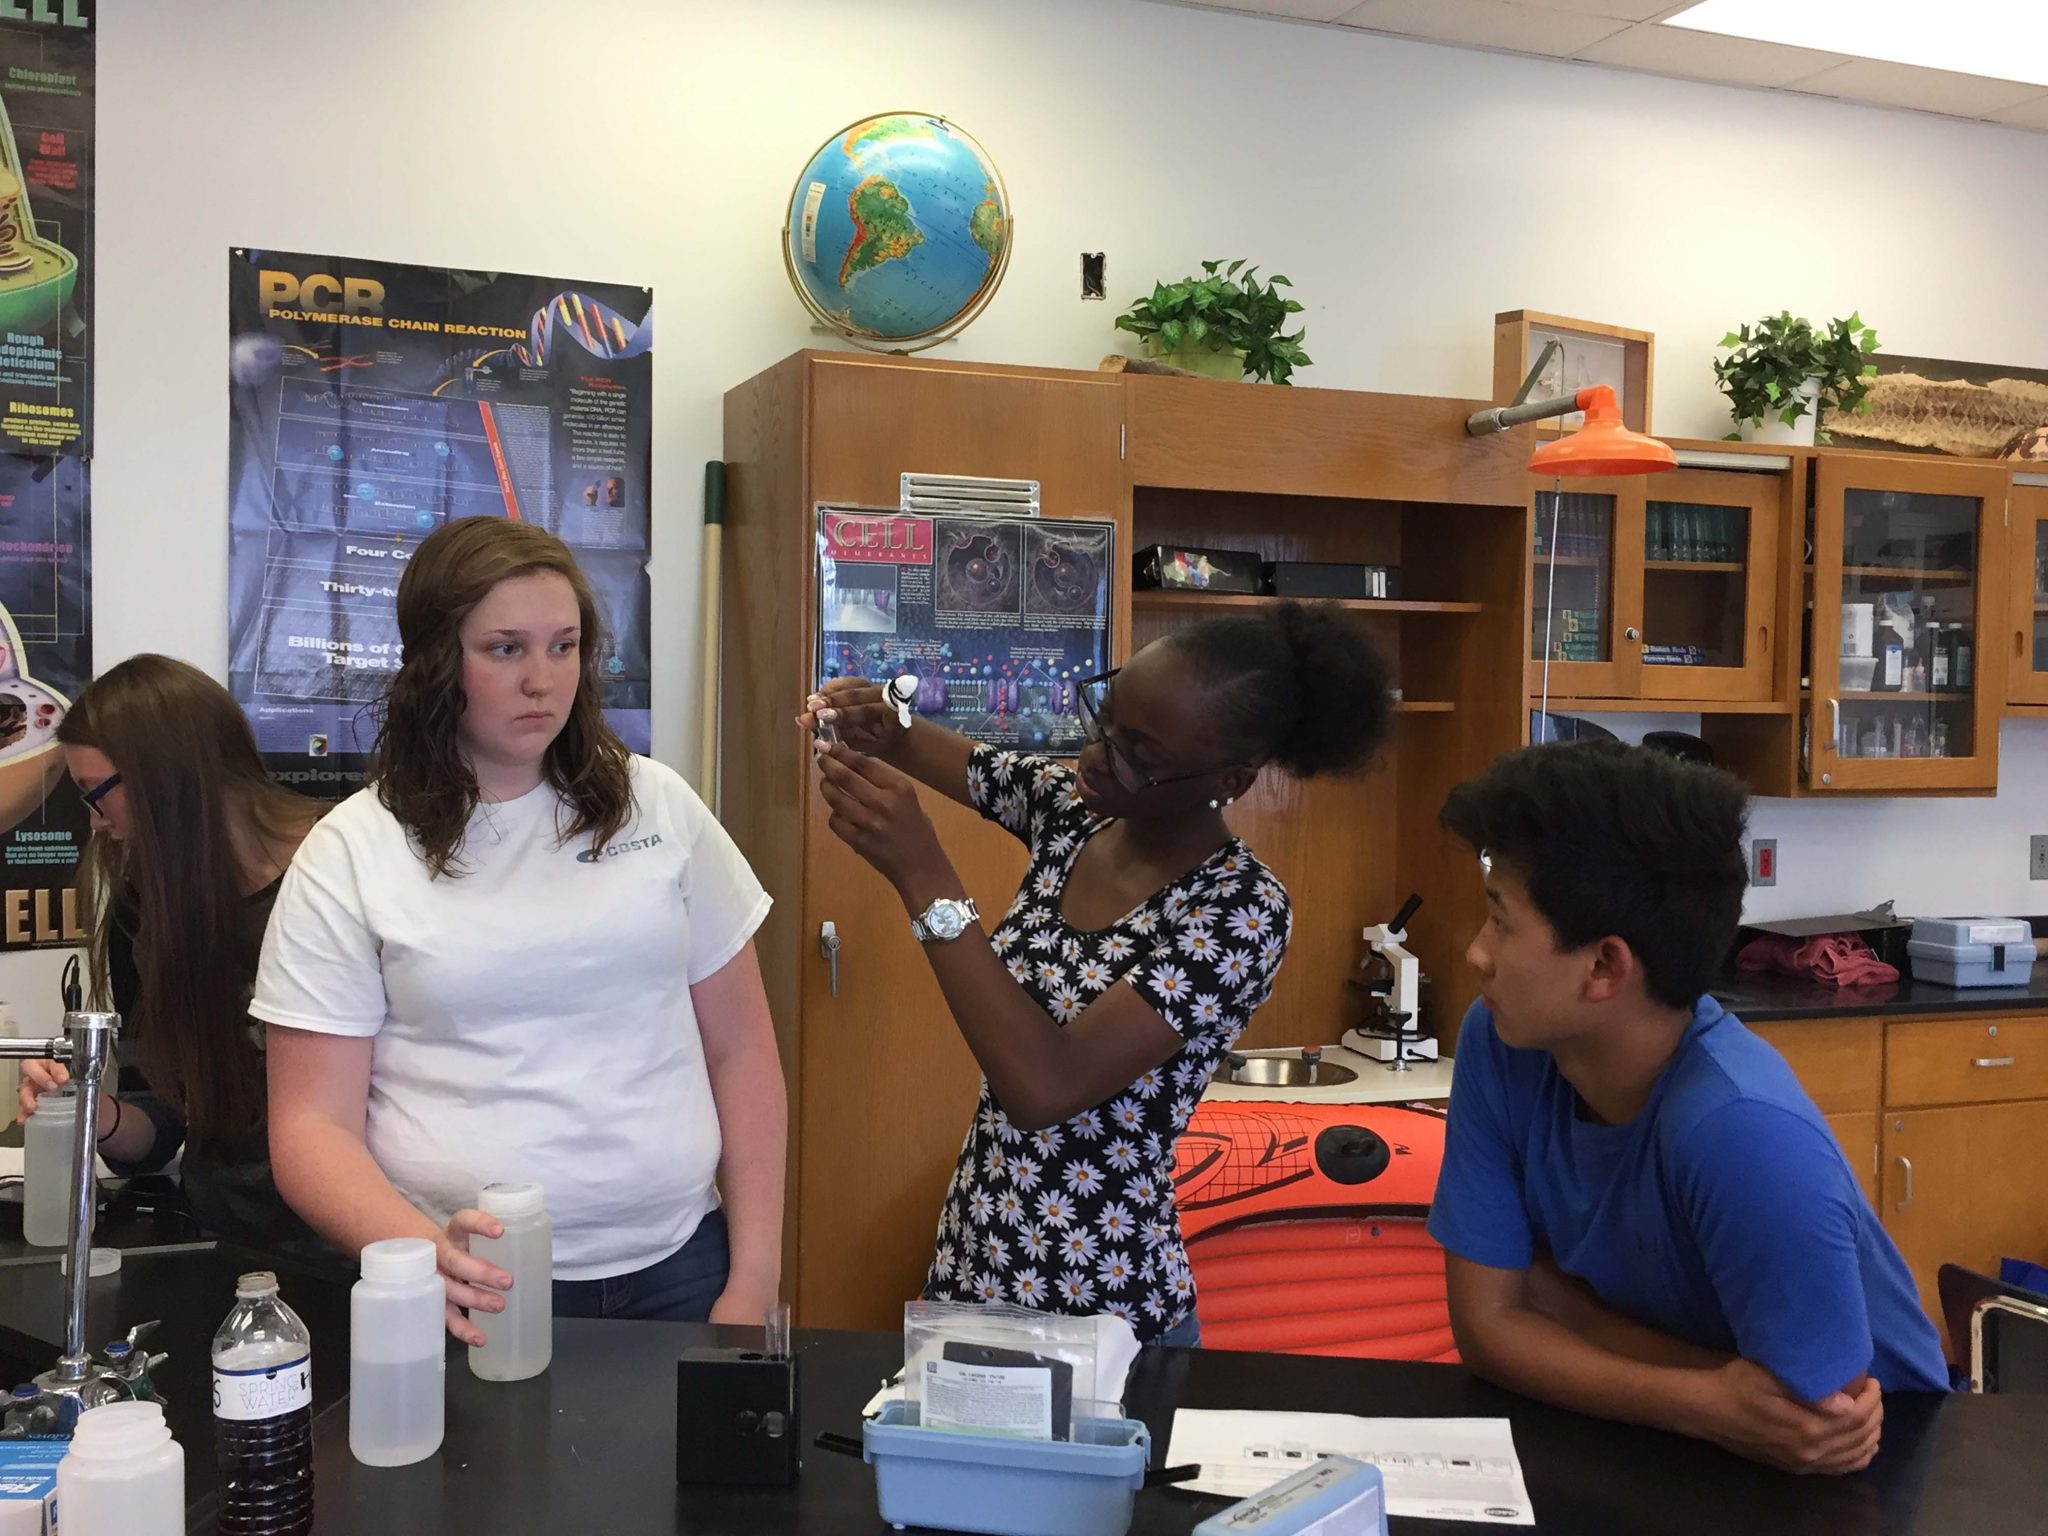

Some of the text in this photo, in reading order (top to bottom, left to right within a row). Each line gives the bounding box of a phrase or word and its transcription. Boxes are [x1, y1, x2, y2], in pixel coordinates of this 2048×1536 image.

[9, 66, 77, 86] Chloroplast
[259, 269, 386, 316] PCR
[269, 309, 527, 339] POLYMERASE CHAIN REACTION
[7, 332, 44, 346] Rough
[0, 345, 63, 360] doplasmic
[9, 401, 74, 418] Ribosomes
[833, 519, 924, 551] CELL
[346, 545, 388, 558] Four
[831, 550, 928, 560] MEMBRANES
[288, 635, 364, 653] Billions
[369, 643, 390, 654] of
[321, 651, 388, 669] Target
[259, 706, 314, 714] Applications
[15, 830, 72, 842] Lysosome
[607, 834, 663, 857] COSTA
[240, 1373, 299, 1397] SPRING
[242, 1388, 297, 1410] WATER
